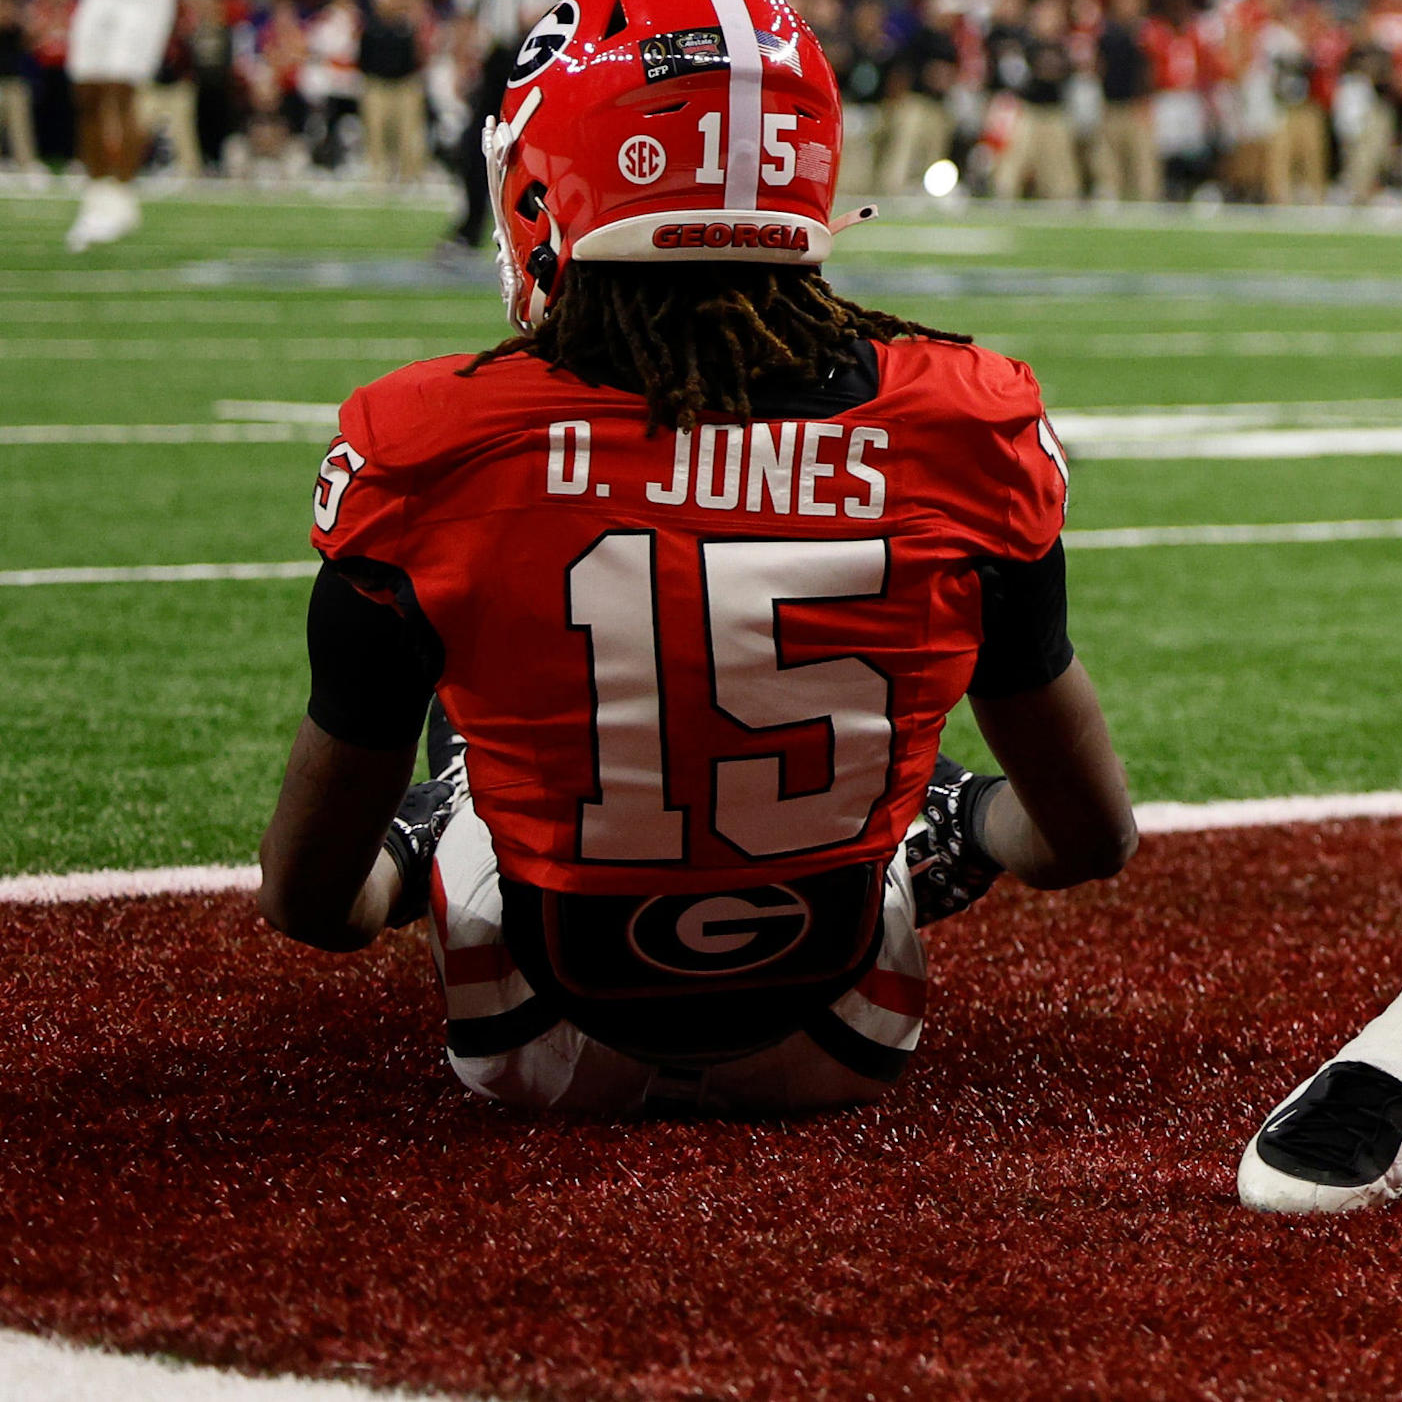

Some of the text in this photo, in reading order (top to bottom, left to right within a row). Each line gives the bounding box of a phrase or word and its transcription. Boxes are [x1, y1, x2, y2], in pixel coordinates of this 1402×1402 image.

[647, 64, 669, 78] CFP
[625, 140, 660, 178] SEC
[652, 221, 810, 252] GEORGIA
[547, 419, 889, 520] D. JONES
[566, 528, 895, 864] 15
